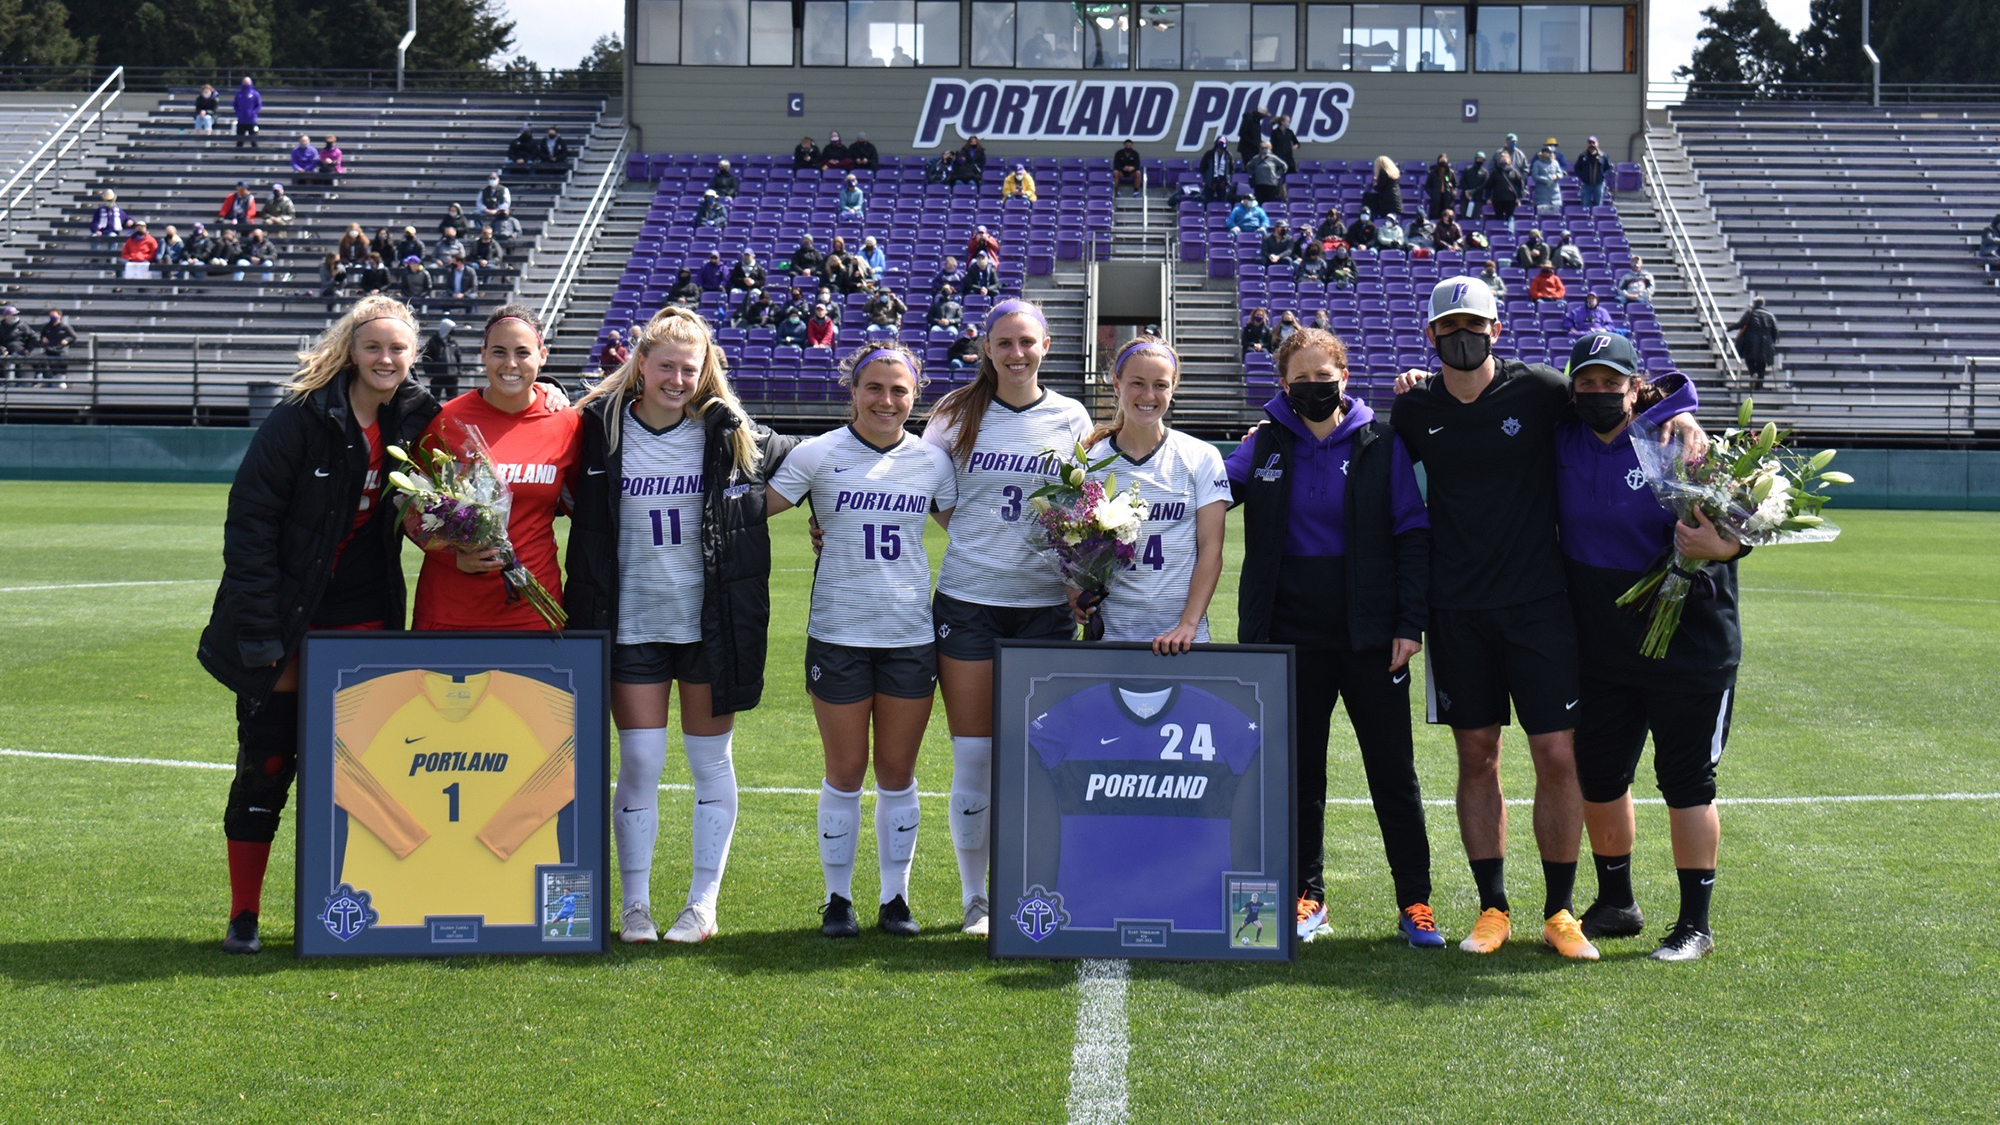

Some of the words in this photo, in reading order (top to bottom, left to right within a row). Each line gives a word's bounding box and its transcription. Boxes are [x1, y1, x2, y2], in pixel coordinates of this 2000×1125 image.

[790, 98, 801, 111] C
[914, 79, 1178, 147] PORTLAND
[1465, 104, 1477, 117] D
[496, 463, 557, 484] RTLAND
[835, 491, 926, 514] PORTLAND
[1001, 485, 1023, 522] 3
[649, 508, 682, 546] 11
[862, 523, 901, 561] 15
[1160, 722, 1217, 761] 24
[408, 751, 509, 777] PORTLAND
[442, 782, 460, 822] 1
[1085, 773, 1208, 801] PORTLAND
